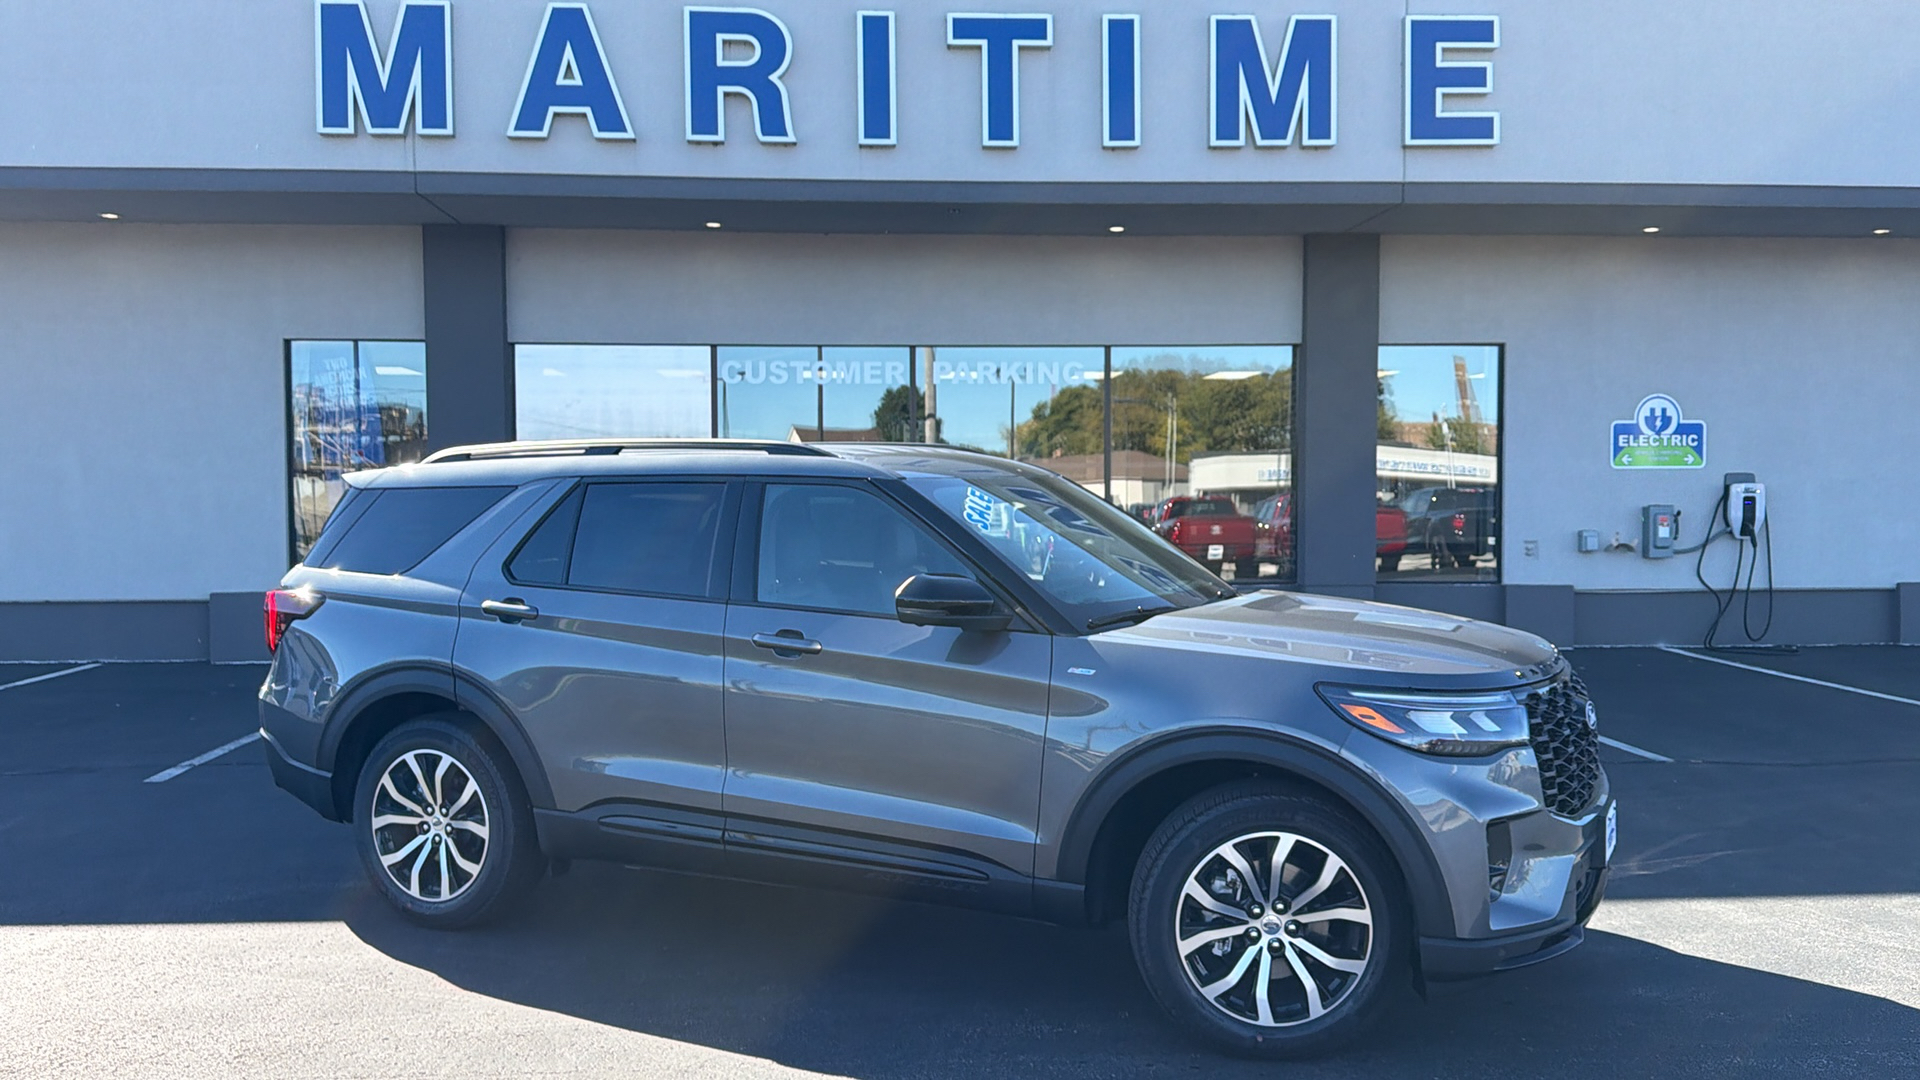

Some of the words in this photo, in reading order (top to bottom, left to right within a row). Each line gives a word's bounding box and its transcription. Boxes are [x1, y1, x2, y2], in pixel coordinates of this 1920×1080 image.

[315, 0, 1500, 148] MARITIME
[721, 360, 905, 385] CUSTOMER
[932, 360, 1085, 385] PARKING
[1618, 434, 1698, 447] ELECTRIC
[963, 486, 994, 531] SALE
